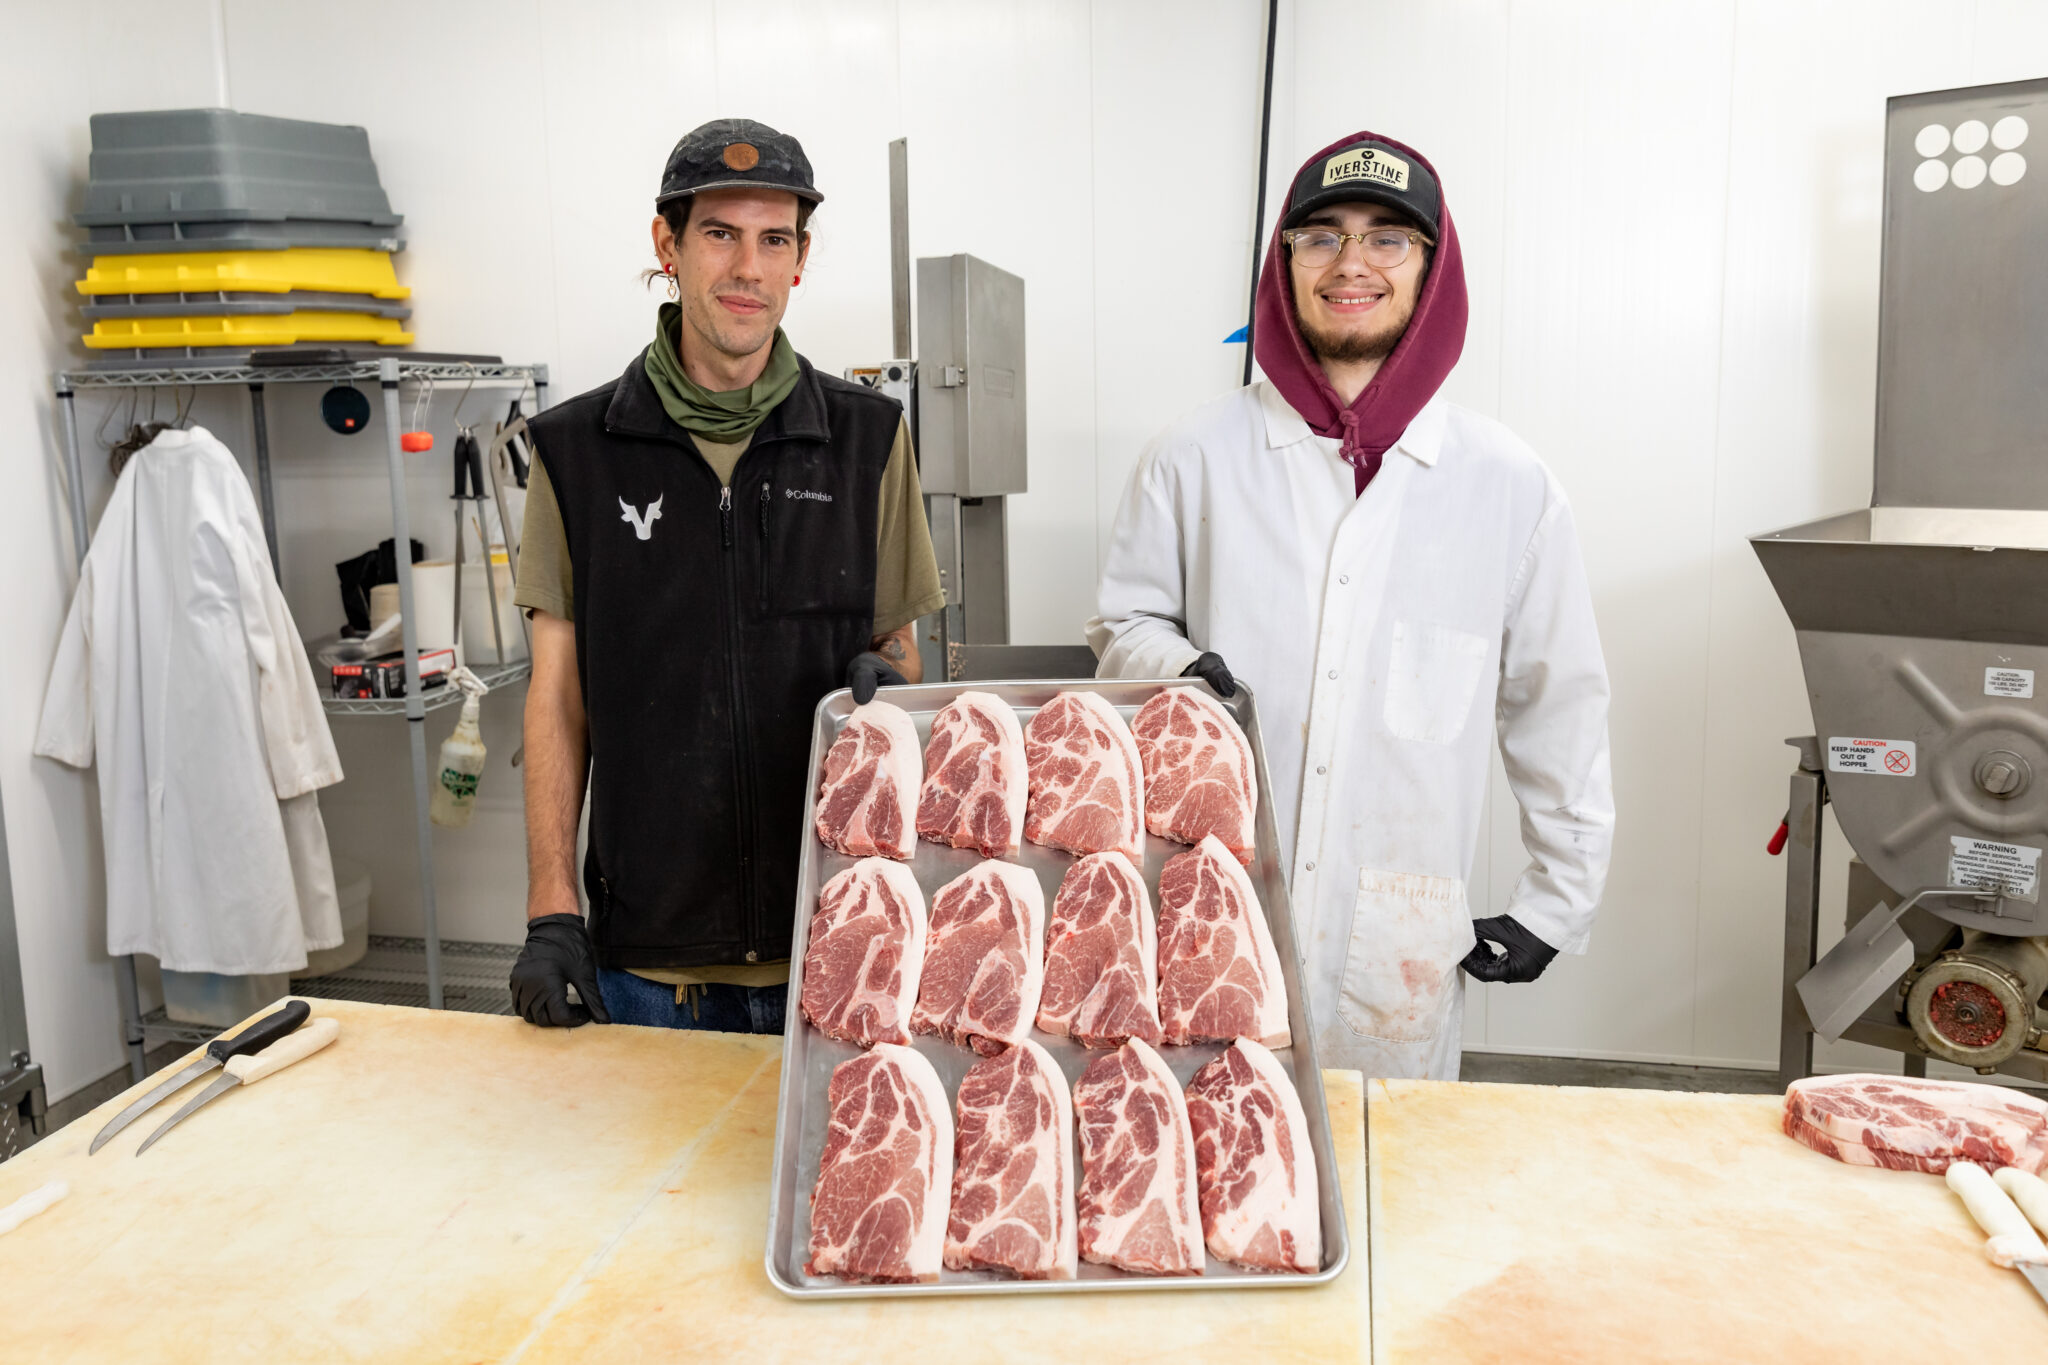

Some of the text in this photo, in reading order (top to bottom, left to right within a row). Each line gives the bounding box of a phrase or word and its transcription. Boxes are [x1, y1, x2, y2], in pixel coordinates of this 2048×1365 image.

[1329, 160, 1403, 183] IVERSTINE
[1333, 173, 1396, 185] FARMS BUTCHER
[793, 489, 833, 502] Columbia
[1853, 739, 1887, 747] CAUTION
[1973, 841, 2017, 855] WARNING
[1968, 849, 2021, 862] BEFORE SERVICING
[1953, 860, 1985, 869] DISENGAGE
[1986, 864, 2013, 873] GRINDING
[1988, 858, 2016, 868] CLEANING
[2017, 863, 2035, 871] PLATE
[1969, 868, 2004, 878] DISCONNECT
[2005, 873, 2030, 882] MACHINE
